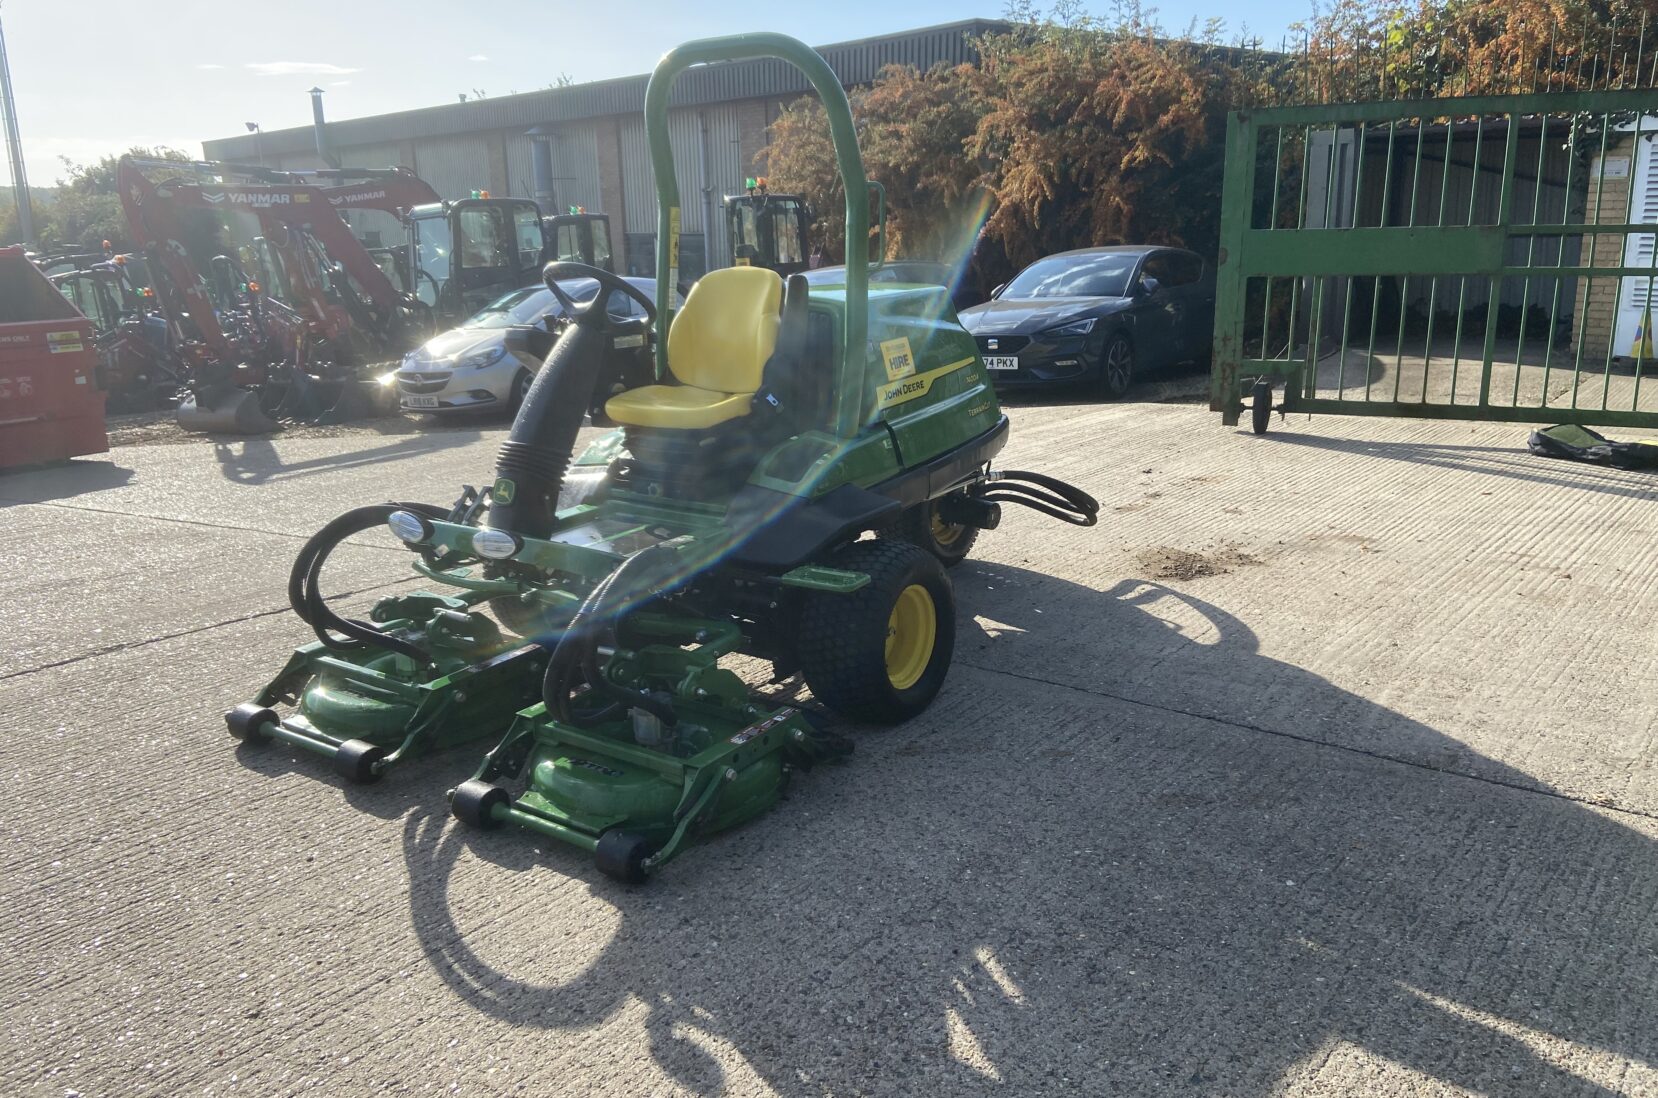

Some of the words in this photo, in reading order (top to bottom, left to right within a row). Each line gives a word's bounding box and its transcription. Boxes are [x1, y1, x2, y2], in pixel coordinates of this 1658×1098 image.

[228, 193, 290, 204] YANMAR
[344, 190, 386, 202] YANMAR
[889, 354, 910, 371] HIRE
[996, 358, 1015, 368] PKX
[884, 384, 903, 400] JOHN
[903, 380, 925, 395] DEERE
